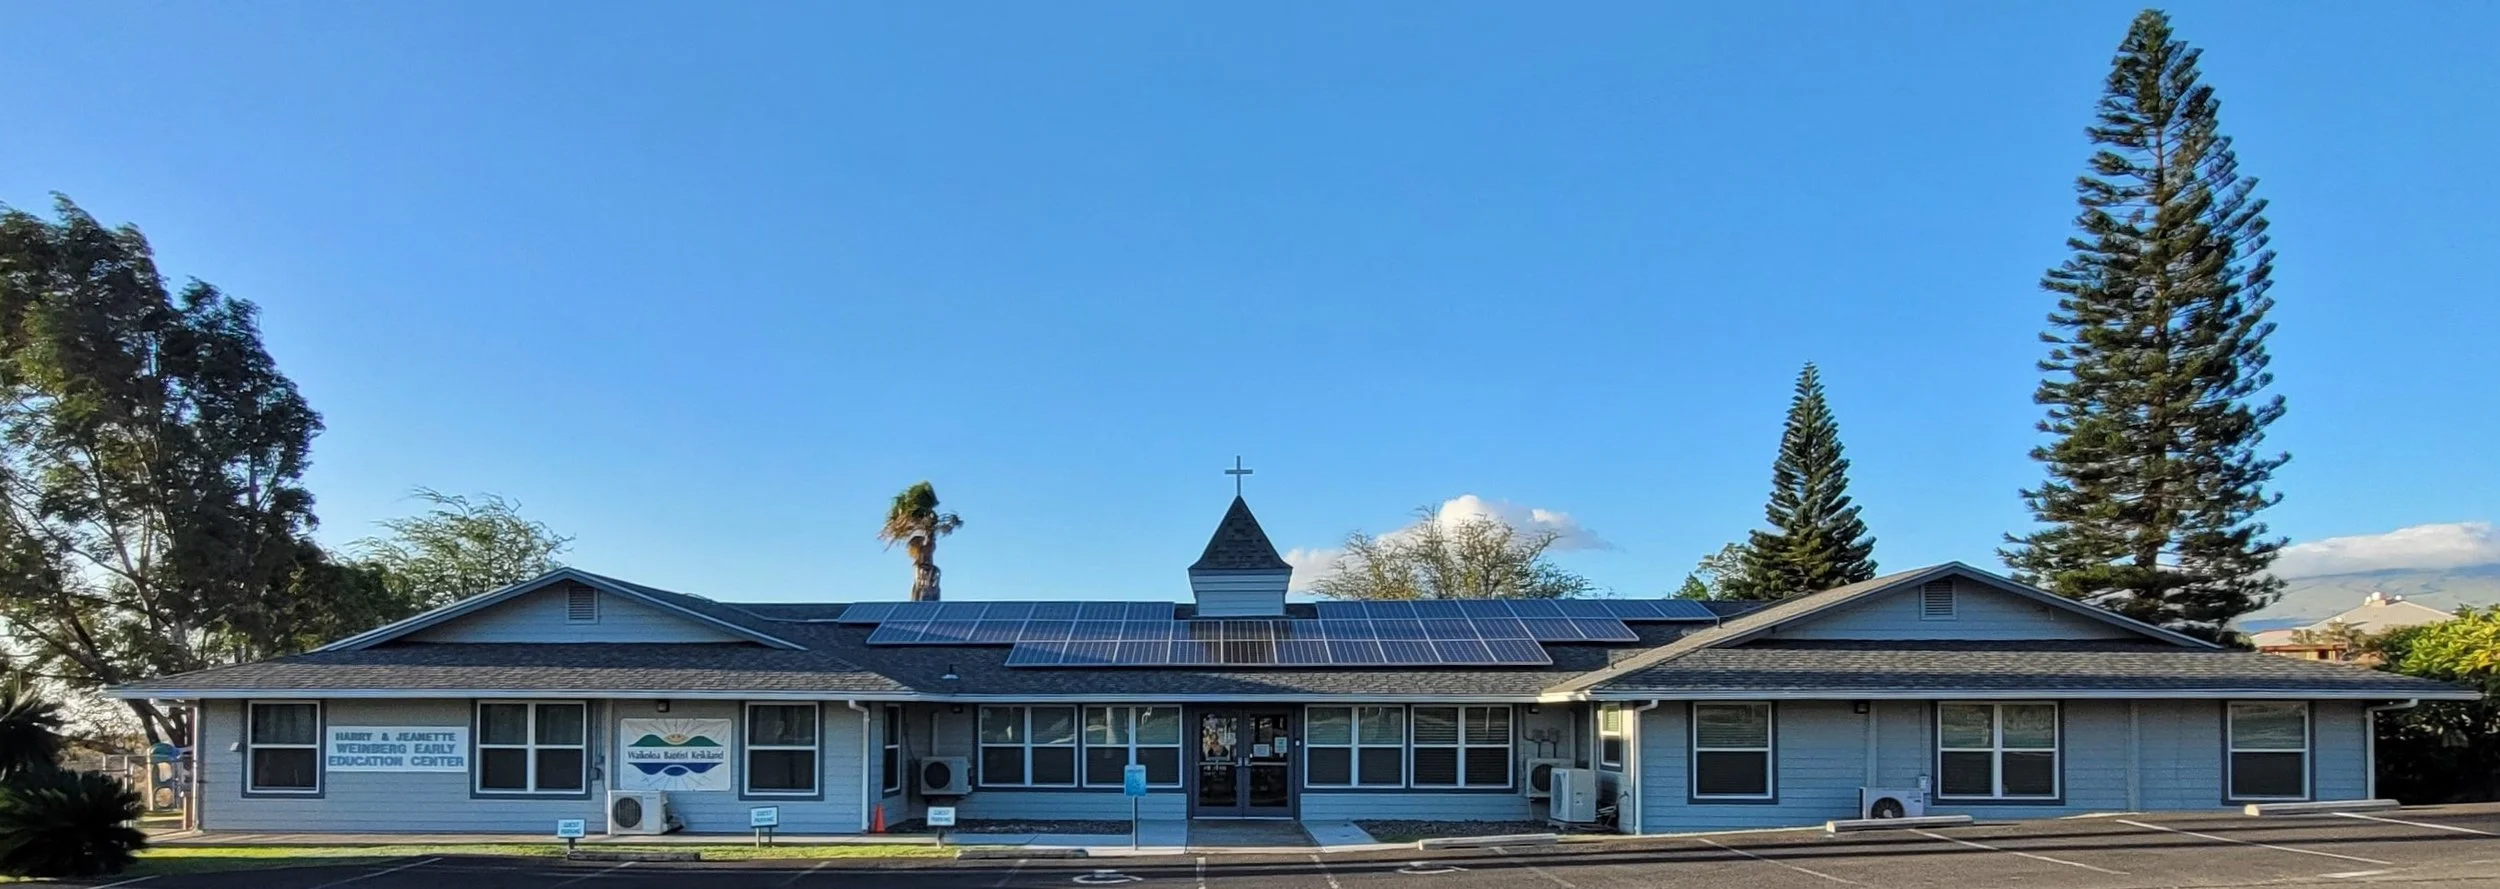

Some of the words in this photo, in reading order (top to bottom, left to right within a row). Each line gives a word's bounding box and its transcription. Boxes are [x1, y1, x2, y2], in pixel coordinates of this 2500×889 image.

[336, 732, 373, 741] HARRY
[381, 732, 390, 741] &
[396, 732, 456, 741] JEANETTE
[336, 744, 407, 754] WEINBERG
[414, 744, 456, 754] EARLY
[628, 750, 660, 760] Waikoloa
[664, 750, 688, 760] Baptist
[328, 756, 403, 766] EDUCATION
[410, 756, 464, 766] CENTER
